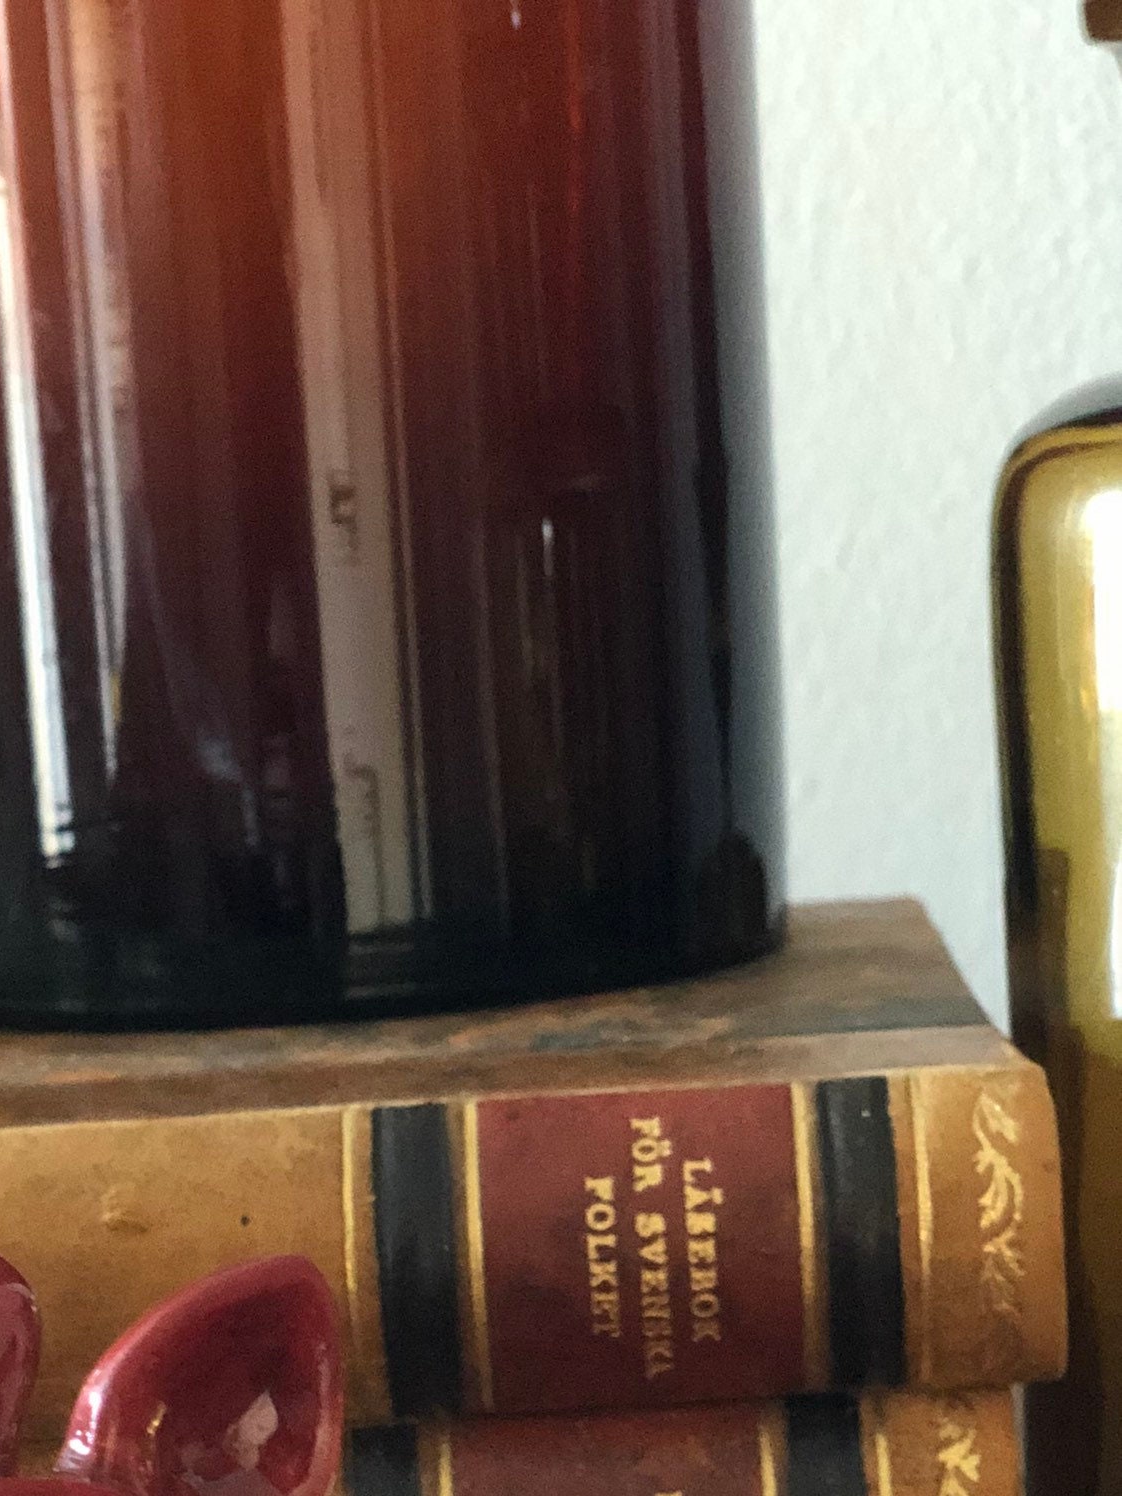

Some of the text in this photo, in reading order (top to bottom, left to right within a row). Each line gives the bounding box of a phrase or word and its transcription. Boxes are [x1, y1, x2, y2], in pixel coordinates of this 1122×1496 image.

[583, 1174, 623, 1339] FOLKET
[629, 1115, 677, 1381] FÖR SVENSKA
[682, 1157, 725, 1343] LÄSEBOK
